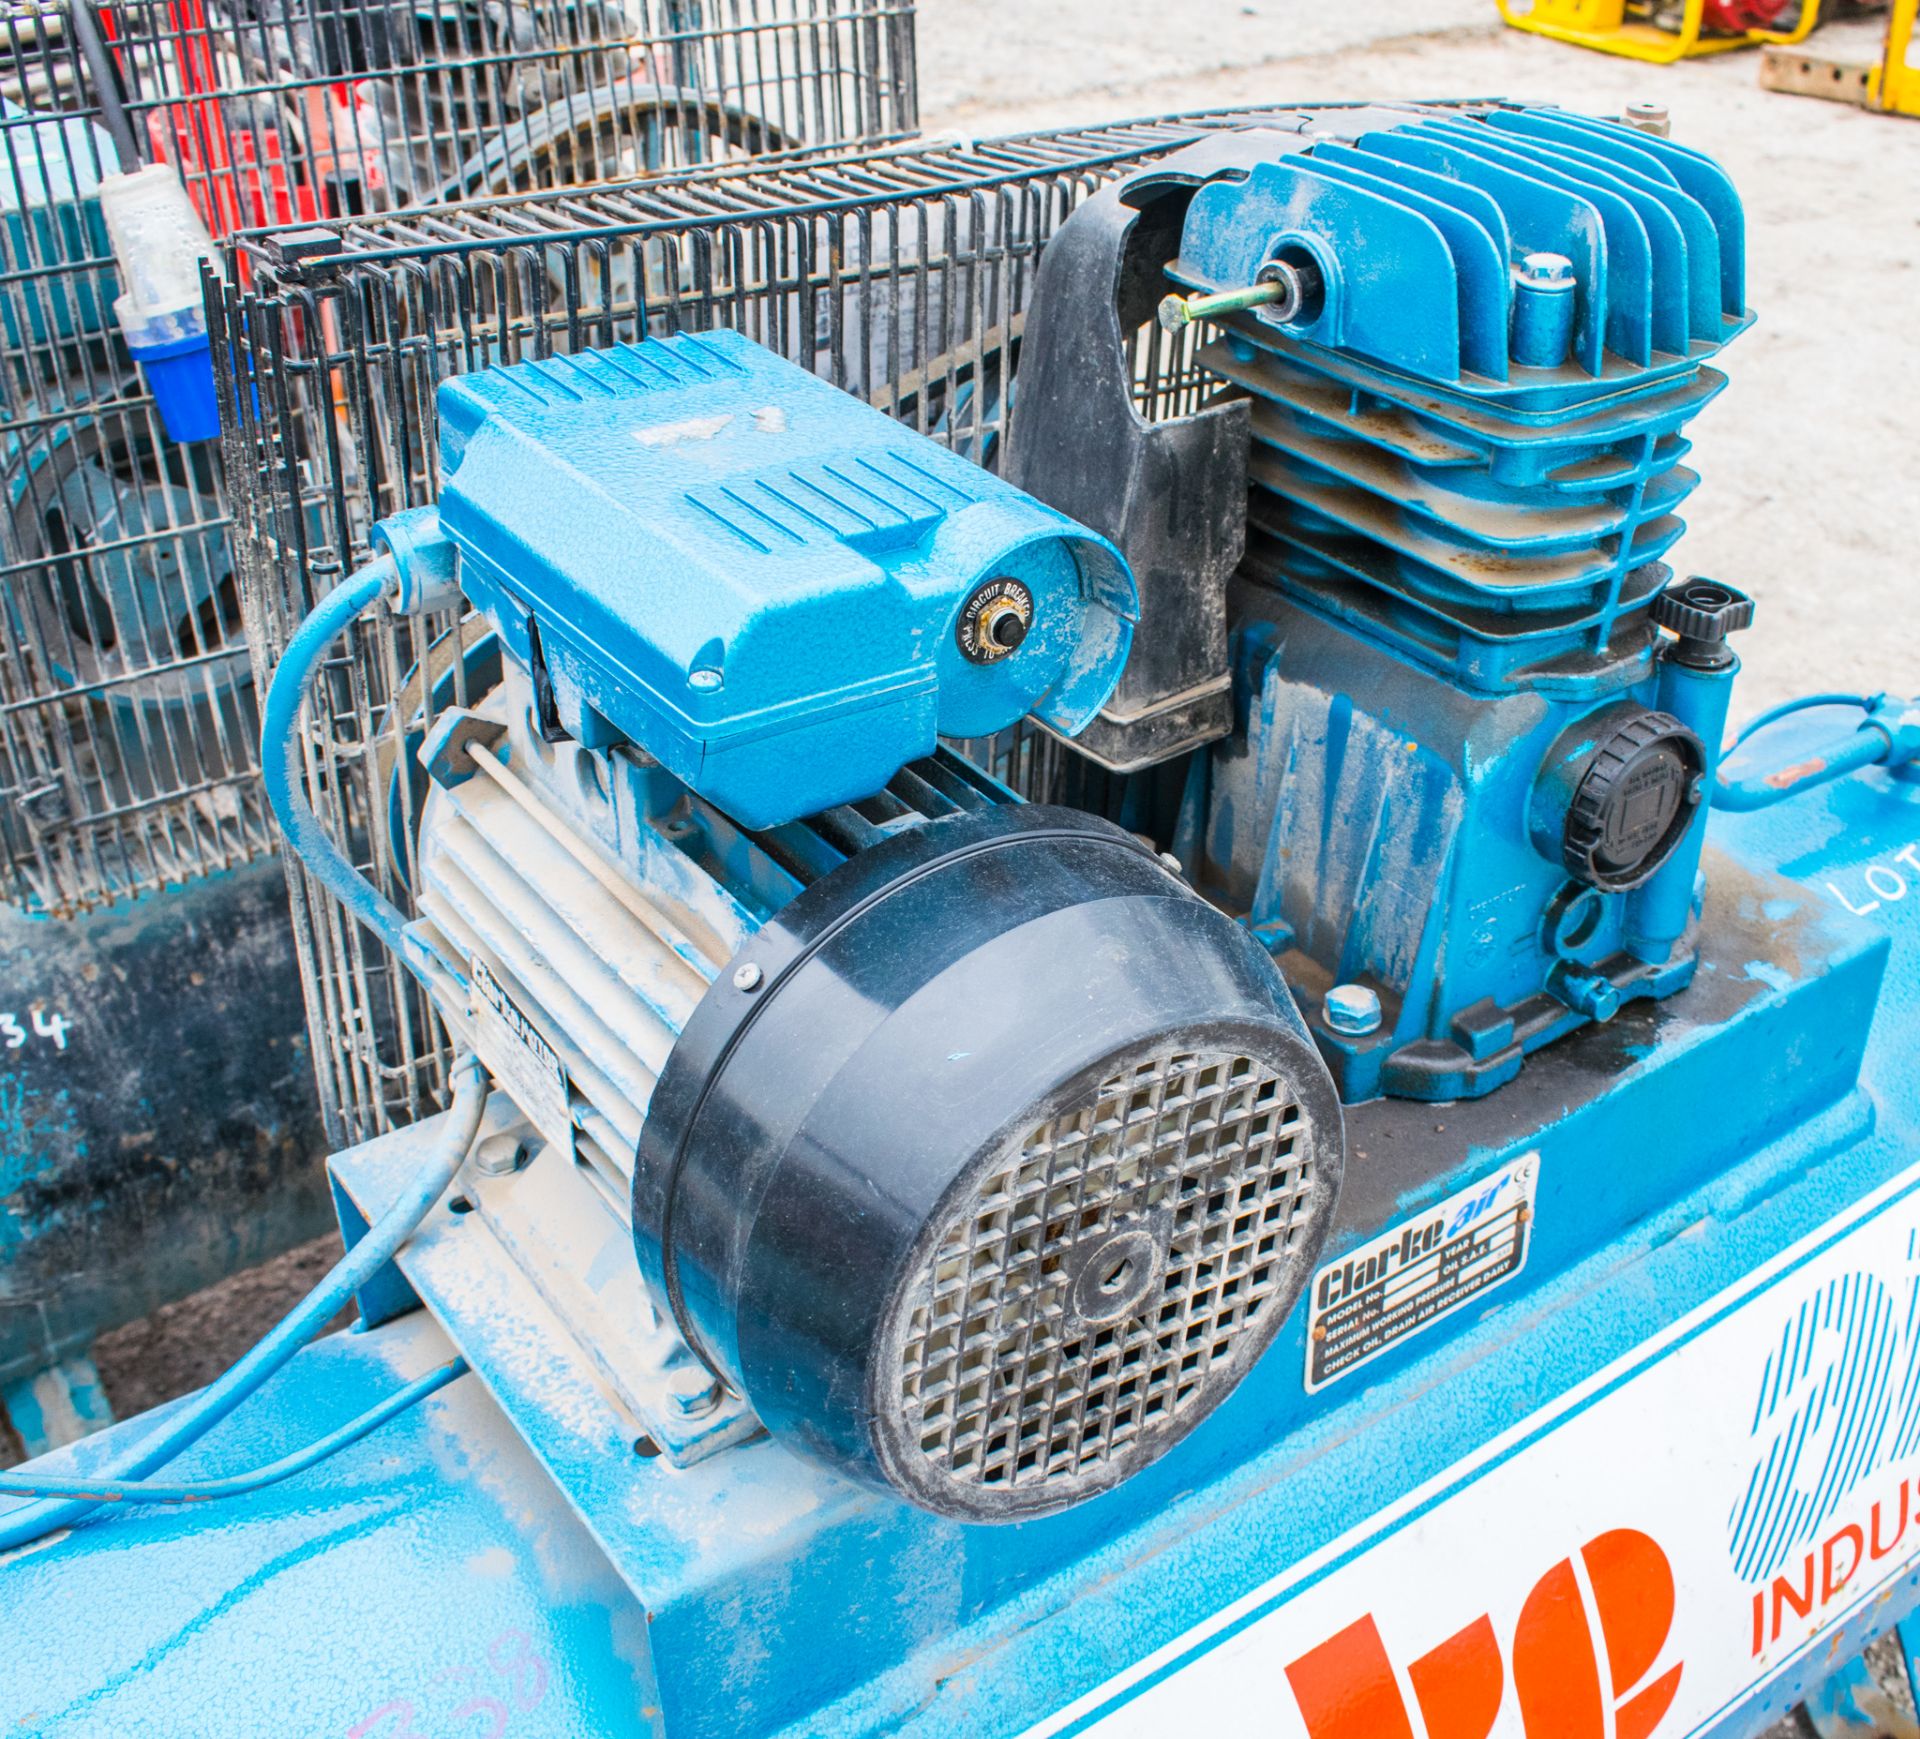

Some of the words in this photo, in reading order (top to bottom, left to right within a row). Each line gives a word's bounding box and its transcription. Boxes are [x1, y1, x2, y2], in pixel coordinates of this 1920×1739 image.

[966, 584, 1000, 619] CIRCUIT
[1318, 1219, 1444, 1311] Clarke
[1447, 1173, 1512, 1239] air
[1327, 1300, 1363, 1326] MODEL
[1445, 1239, 1470, 1259] YEAR
[1323, 1348, 1360, 1374] CHECK
[1384, 1315, 1416, 1340] DRAIN
[1417, 1304, 1435, 1320] AIR
[1437, 1277, 1481, 1309] RECEIVER
[1483, 1260, 1511, 1282] DAILY
[1324, 1326, 1370, 1358] MAXIMUM
[1371, 1301, 1414, 1331] WORKING
[1415, 1277, 1456, 1306] PRESSURE
[1325, 1317, 1359, 1342] SERIAL
[1442, 1260, 1459, 1275] OIL
[1751, 1476, 1920, 1658] INDU
